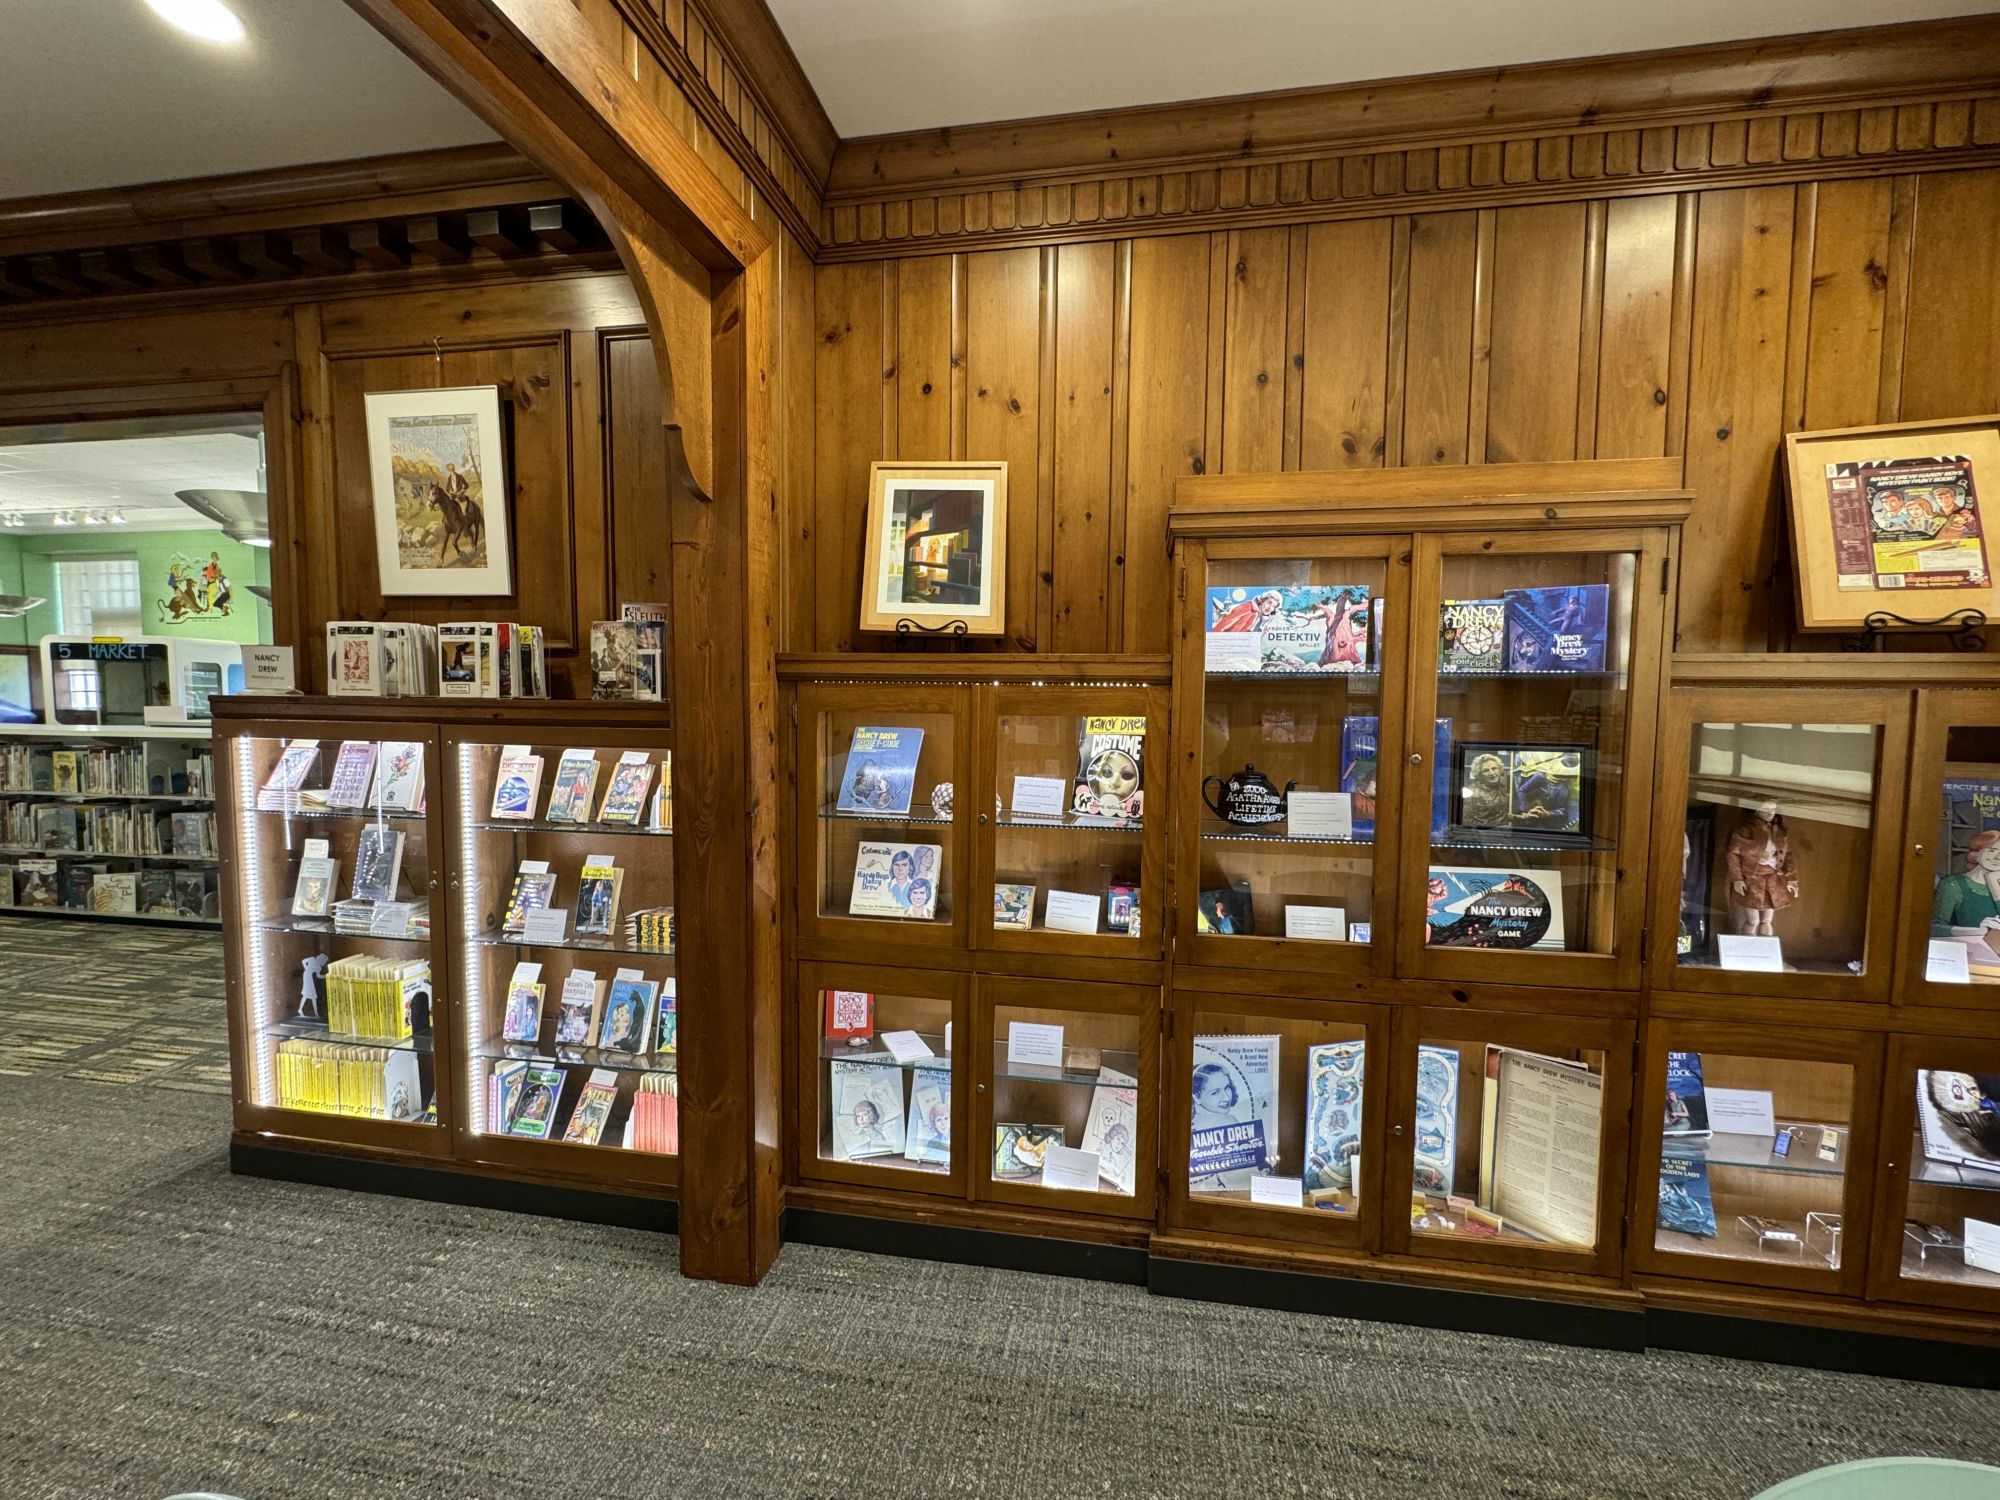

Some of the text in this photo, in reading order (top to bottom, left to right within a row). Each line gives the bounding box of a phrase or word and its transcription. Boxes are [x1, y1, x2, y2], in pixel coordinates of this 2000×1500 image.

[629, 612, 667, 621] SLEUTH
[1447, 606, 1504, 617] NANCY
[1451, 616, 1497, 629] DREW
[1267, 632, 1321, 642] DETEKTIV
[1553, 633, 1583, 642] Nancy
[1557, 639, 1583, 648] Drew
[58, 643, 149, 660] 5 MARKET
[1550, 647, 1590, 657] Mystery
[254, 653, 281, 662] NANCY
[1469, 659, 1495, 668] Clock
[258, 665, 278, 673] DREW
[879, 732, 899, 740] DREW
[1090, 734, 1143, 761] COSTUME
[1226, 791, 1264, 804] AGATHA
[1972, 792, 2000, 808] Nan
[1235, 803, 1278, 815] LIFETIME
[857, 870, 876, 881] Hardy
[1470, 905, 1543, 917] NANCY DREW
[1488, 917, 1529, 931] Mystery
[1497, 930, 1522, 938] GAME
[839, 995, 864, 1003] NANCY
[838, 1013, 863, 1022] DIARY
[875, 1055, 897, 1063] DREW
[1512, 1059, 1601, 1090] THE NANCY DREW MYSTERY GAM
[1192, 1123, 1256, 1149] NANCY DREW
[1190, 1136, 1265, 1159] Trouble Shooter
[1670, 1159, 1693, 1167] SECRET
[1660, 1168, 1684, 1176] OODEN
